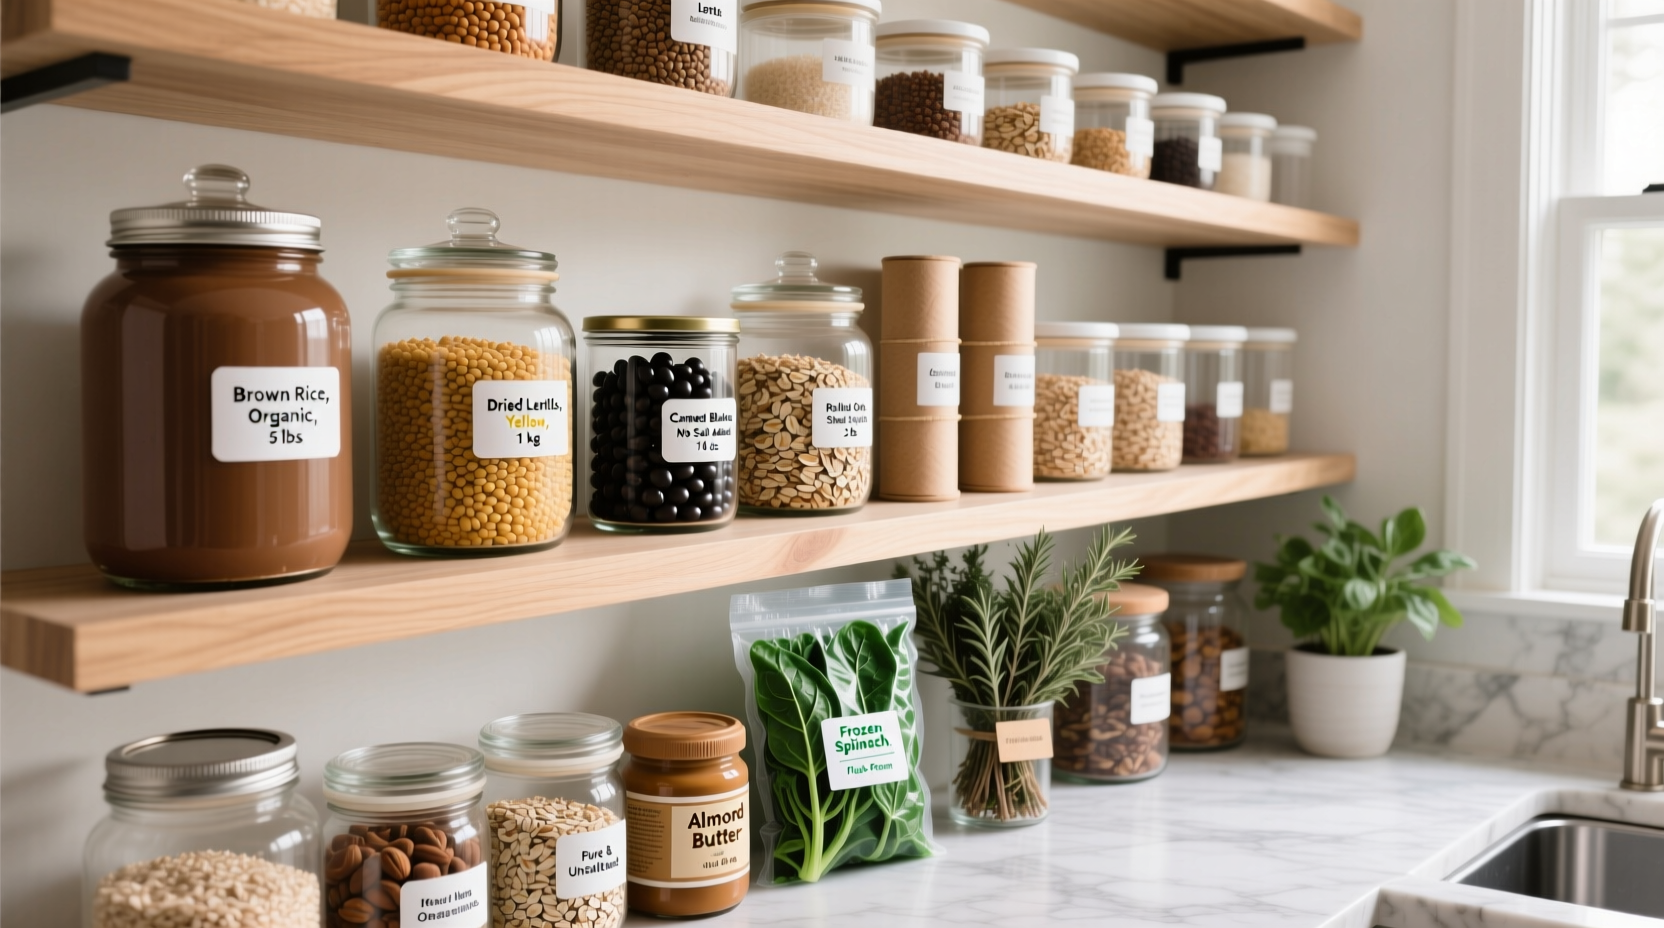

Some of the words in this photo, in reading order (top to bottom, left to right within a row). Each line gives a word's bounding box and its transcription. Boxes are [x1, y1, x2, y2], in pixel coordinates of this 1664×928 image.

[233, 386, 290, 403] Brown
[295, 385, 329, 405] Rice,
[487, 397, 523, 412] Dried
[248, 407, 318, 428] Organic,
[505, 414, 549, 430] Yellow,
[269, 430, 278, 444] 5
[281, 428, 303, 444] lbs
[516, 432, 522, 445] 1
[527, 431, 541, 447] kg
[676, 427, 691, 438] No
[840, 725, 882, 738] Frozen
[687, 802, 744, 829] Almond
[692, 828, 743, 849] Butter
[581, 849, 603, 862] Pure
